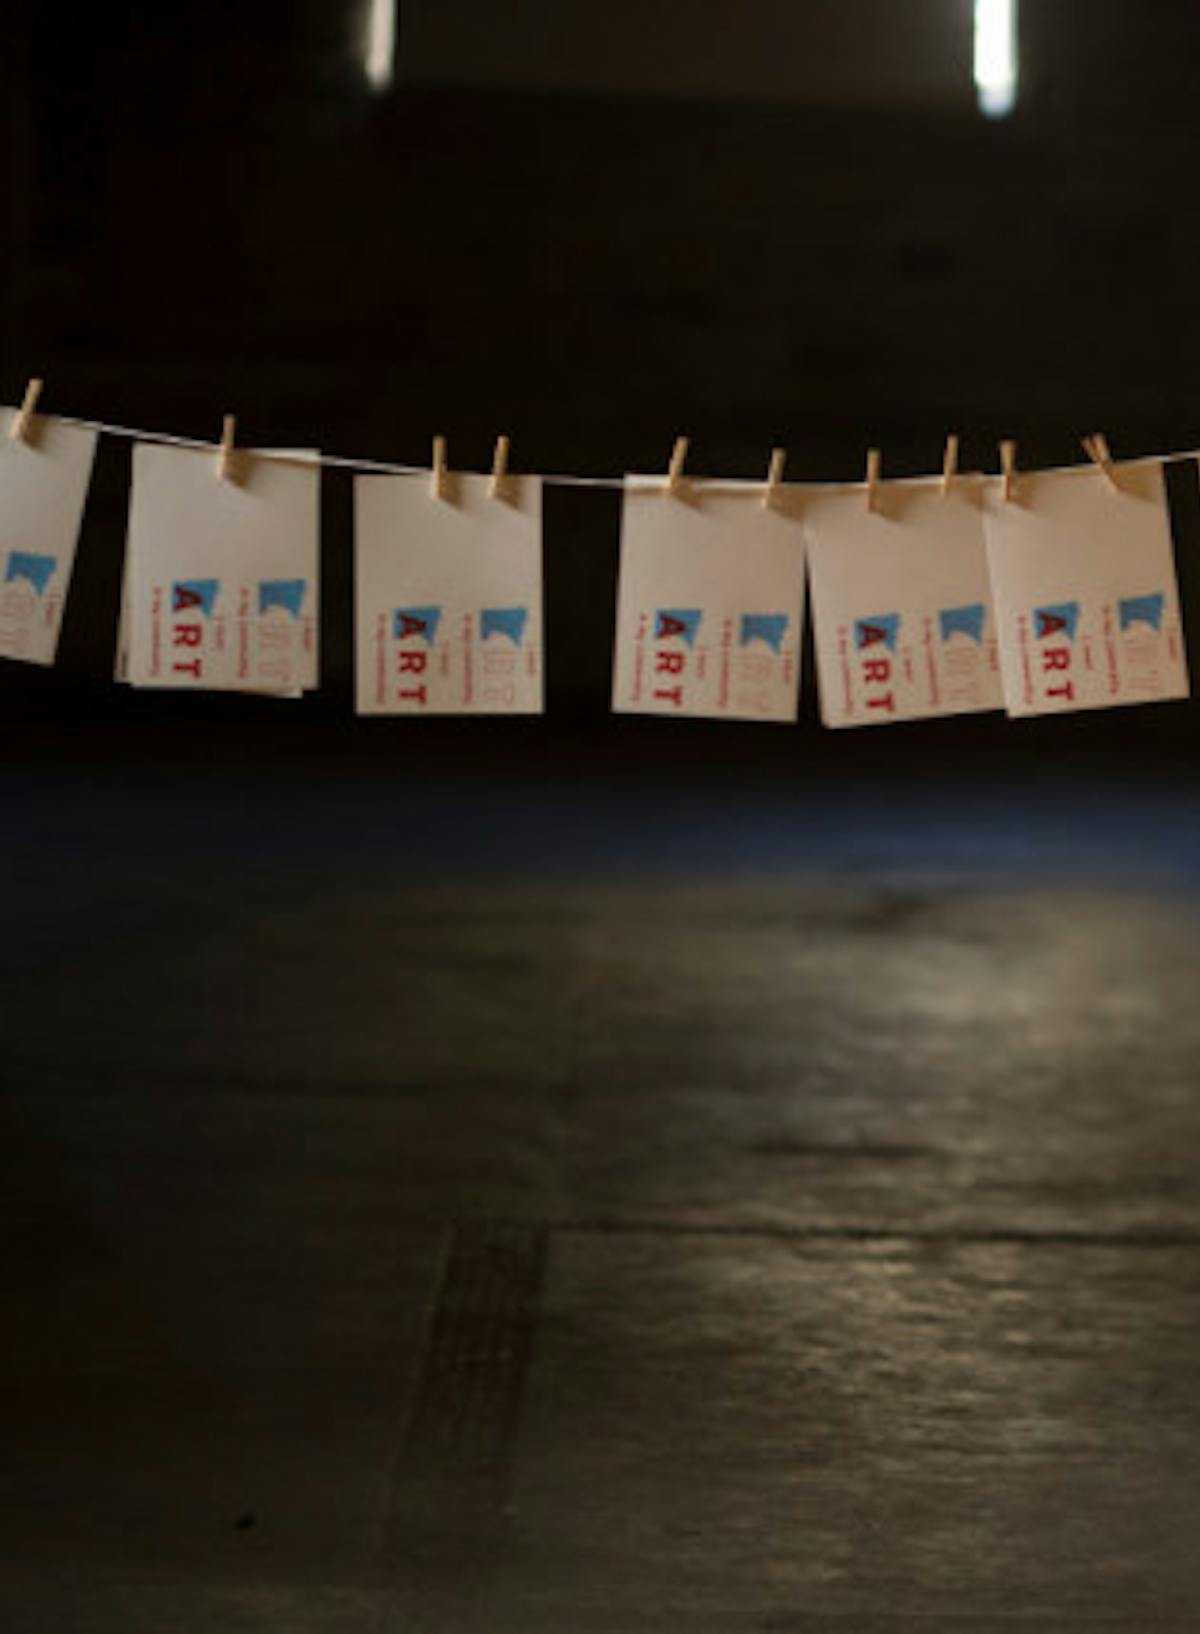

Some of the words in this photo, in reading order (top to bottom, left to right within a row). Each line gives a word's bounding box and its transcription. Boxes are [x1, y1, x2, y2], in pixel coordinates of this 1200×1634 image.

[172, 585, 203, 679] ART
[398, 614, 428, 706] ART
[653, 615, 687, 706] ART
[857, 623, 894, 713] ART
[1038, 612, 1074, 702] ART
